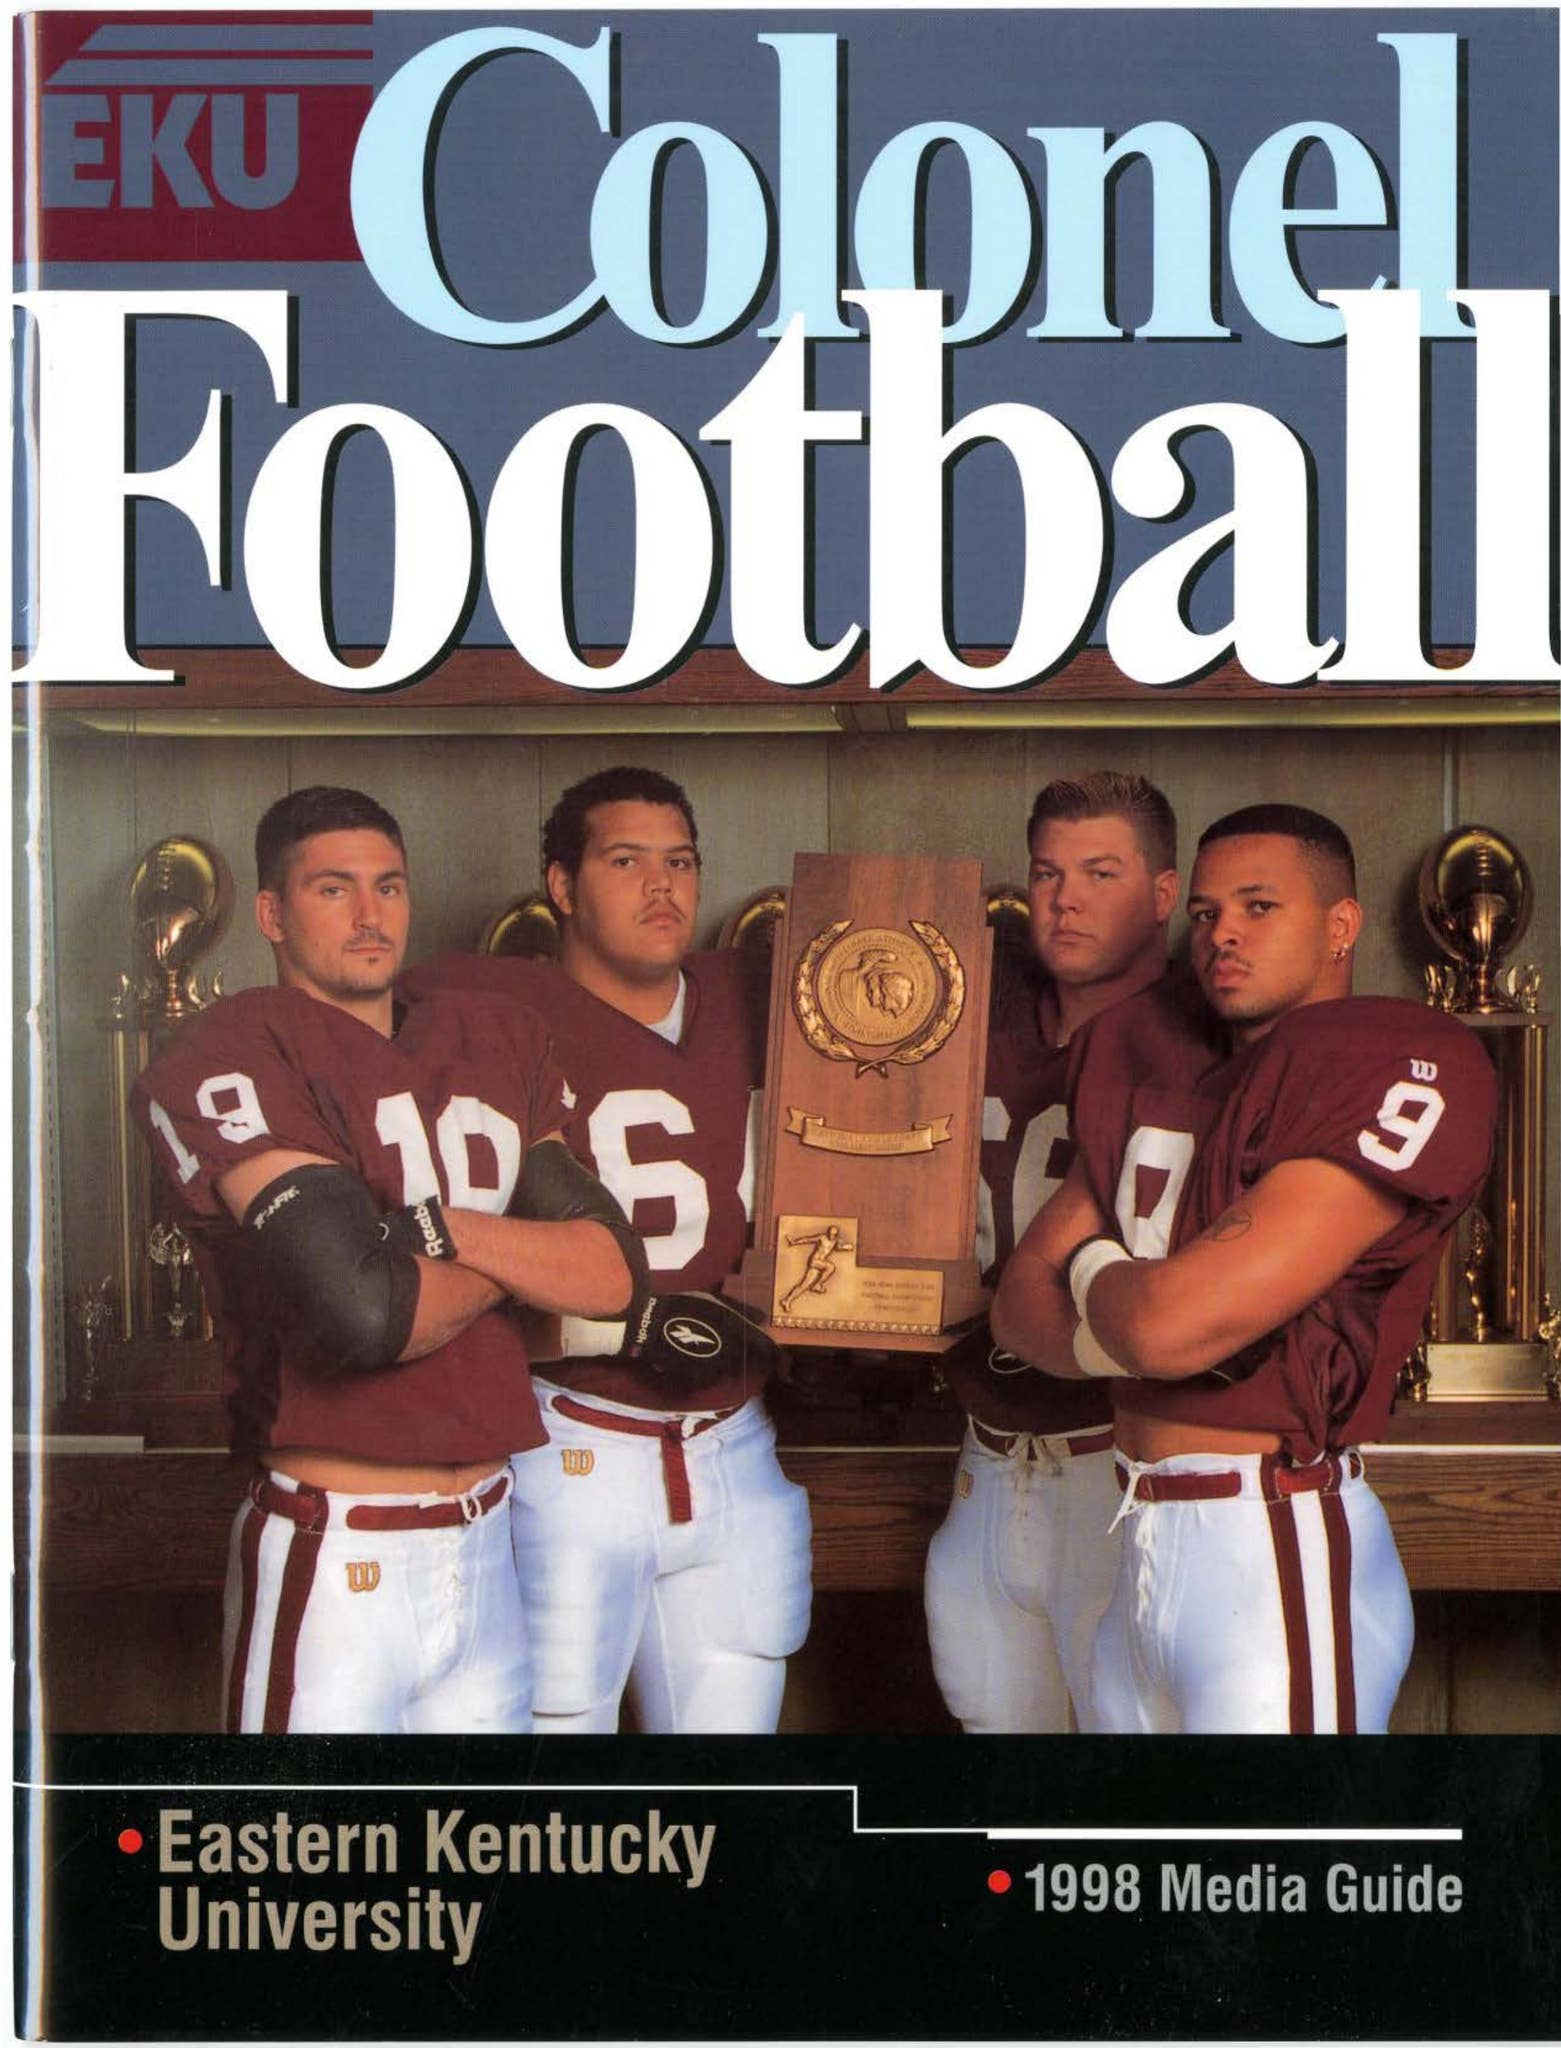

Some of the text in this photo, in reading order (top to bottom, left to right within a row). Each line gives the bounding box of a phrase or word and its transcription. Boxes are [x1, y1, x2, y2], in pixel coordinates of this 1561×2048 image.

[41, 92, 299, 209] EKU
[350, 26, 1478, 346] Colonel
[12, 289, 1561, 691] Football
[1357, 1081, 1445, 1172] 9
[160, 1810, 715, 1888] Eastern Kentucky
[1025, 1864, 1462, 1912] 1998 Media Guide
[160, 1887, 481, 1965] University
